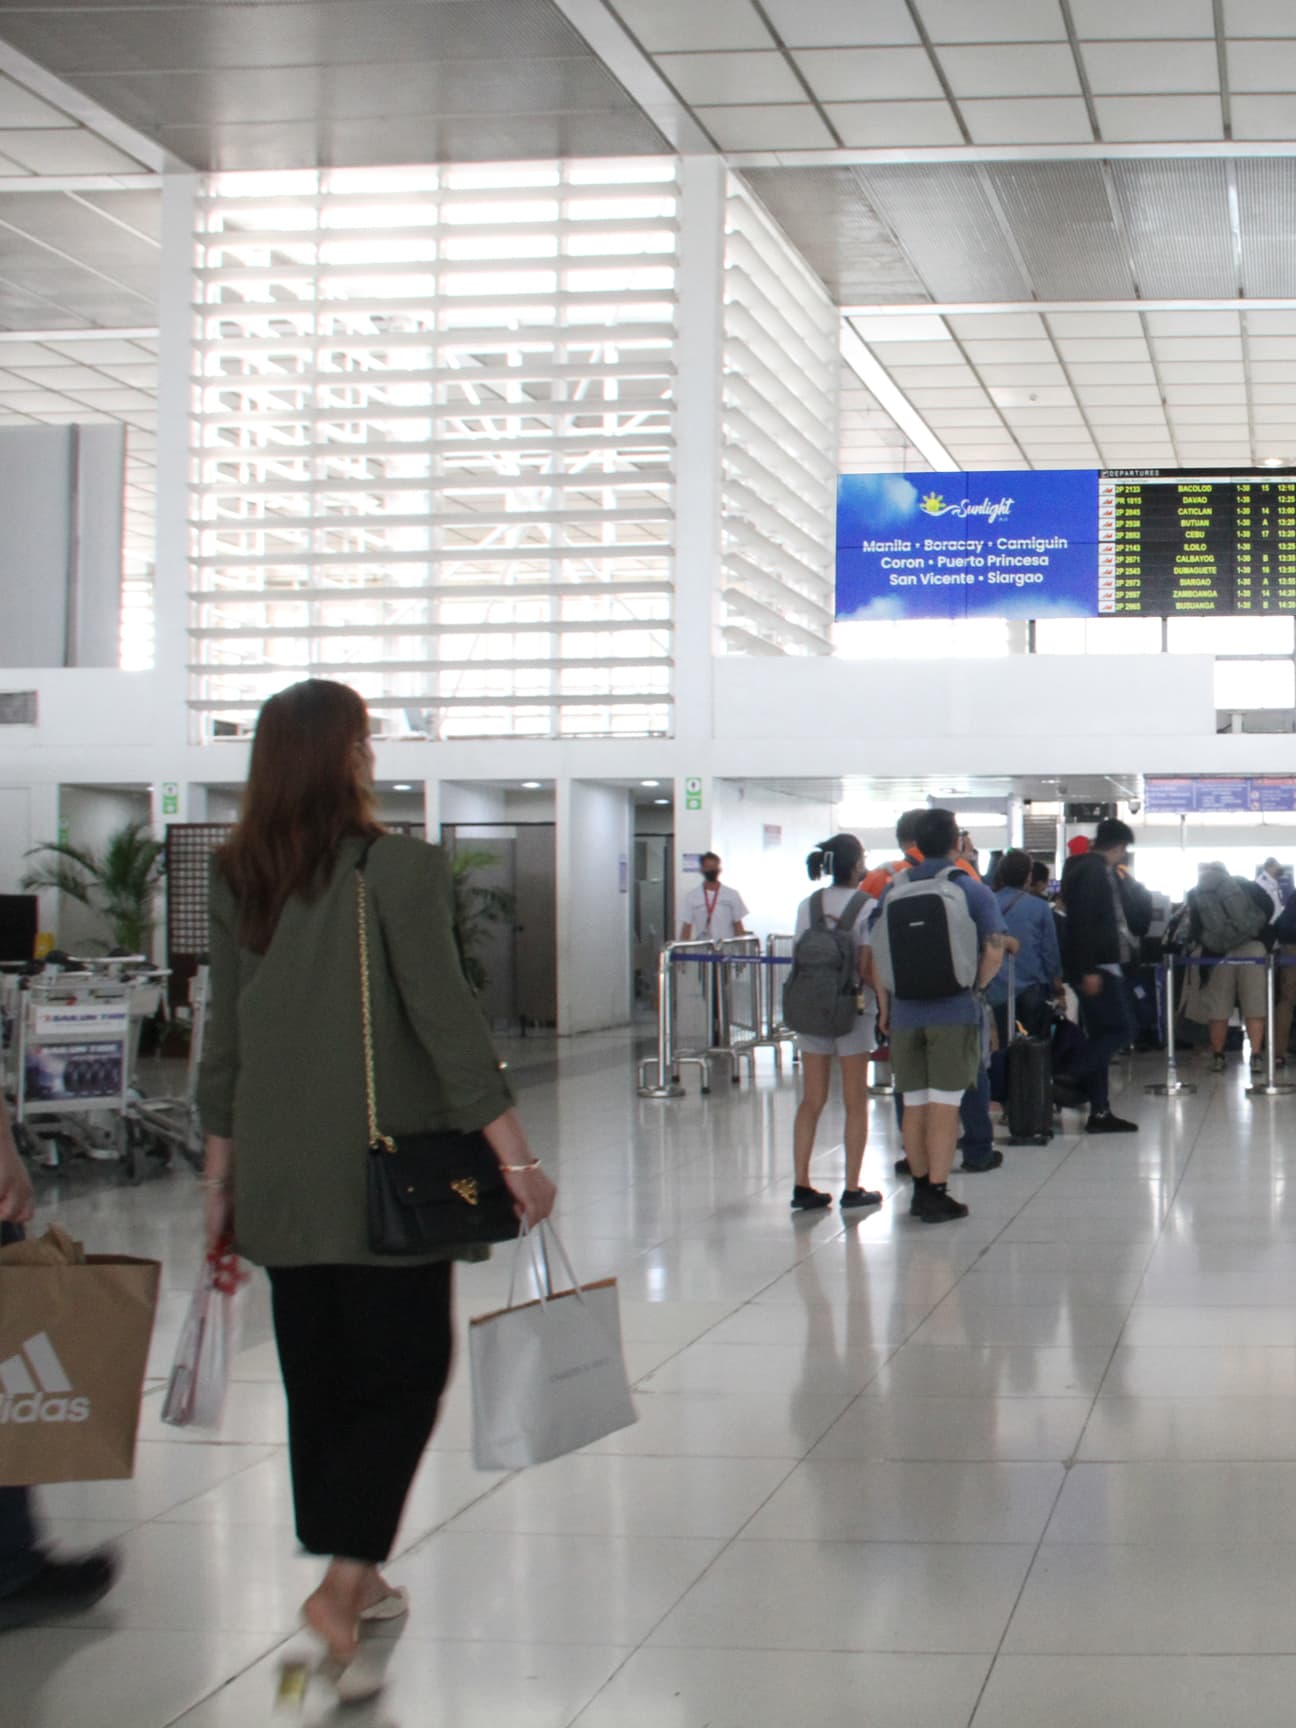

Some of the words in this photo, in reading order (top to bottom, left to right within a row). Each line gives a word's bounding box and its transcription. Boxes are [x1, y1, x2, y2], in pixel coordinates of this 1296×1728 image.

[1183, 496, 1208, 505] DAVAO
[952, 498, 1015, 523] Sunlight
[1178, 507, 1213, 516] CATICLAN
[1185, 530, 1206, 539] CEBU
[863, 539, 911, 552] Manila
[924, 538, 984, 554] Boracay
[996, 536, 1068, 553] Camiguin
[881, 555, 925, 569] Coron
[937, 555, 985, 568] Puerto
[987, 554, 1049, 567] Princesa
[889, 573, 919, 586] San
[920, 572, 975, 585] Vicente
[987, 570, 1044, 586] Siargao
[0, 1391, 91, 1424] idas
